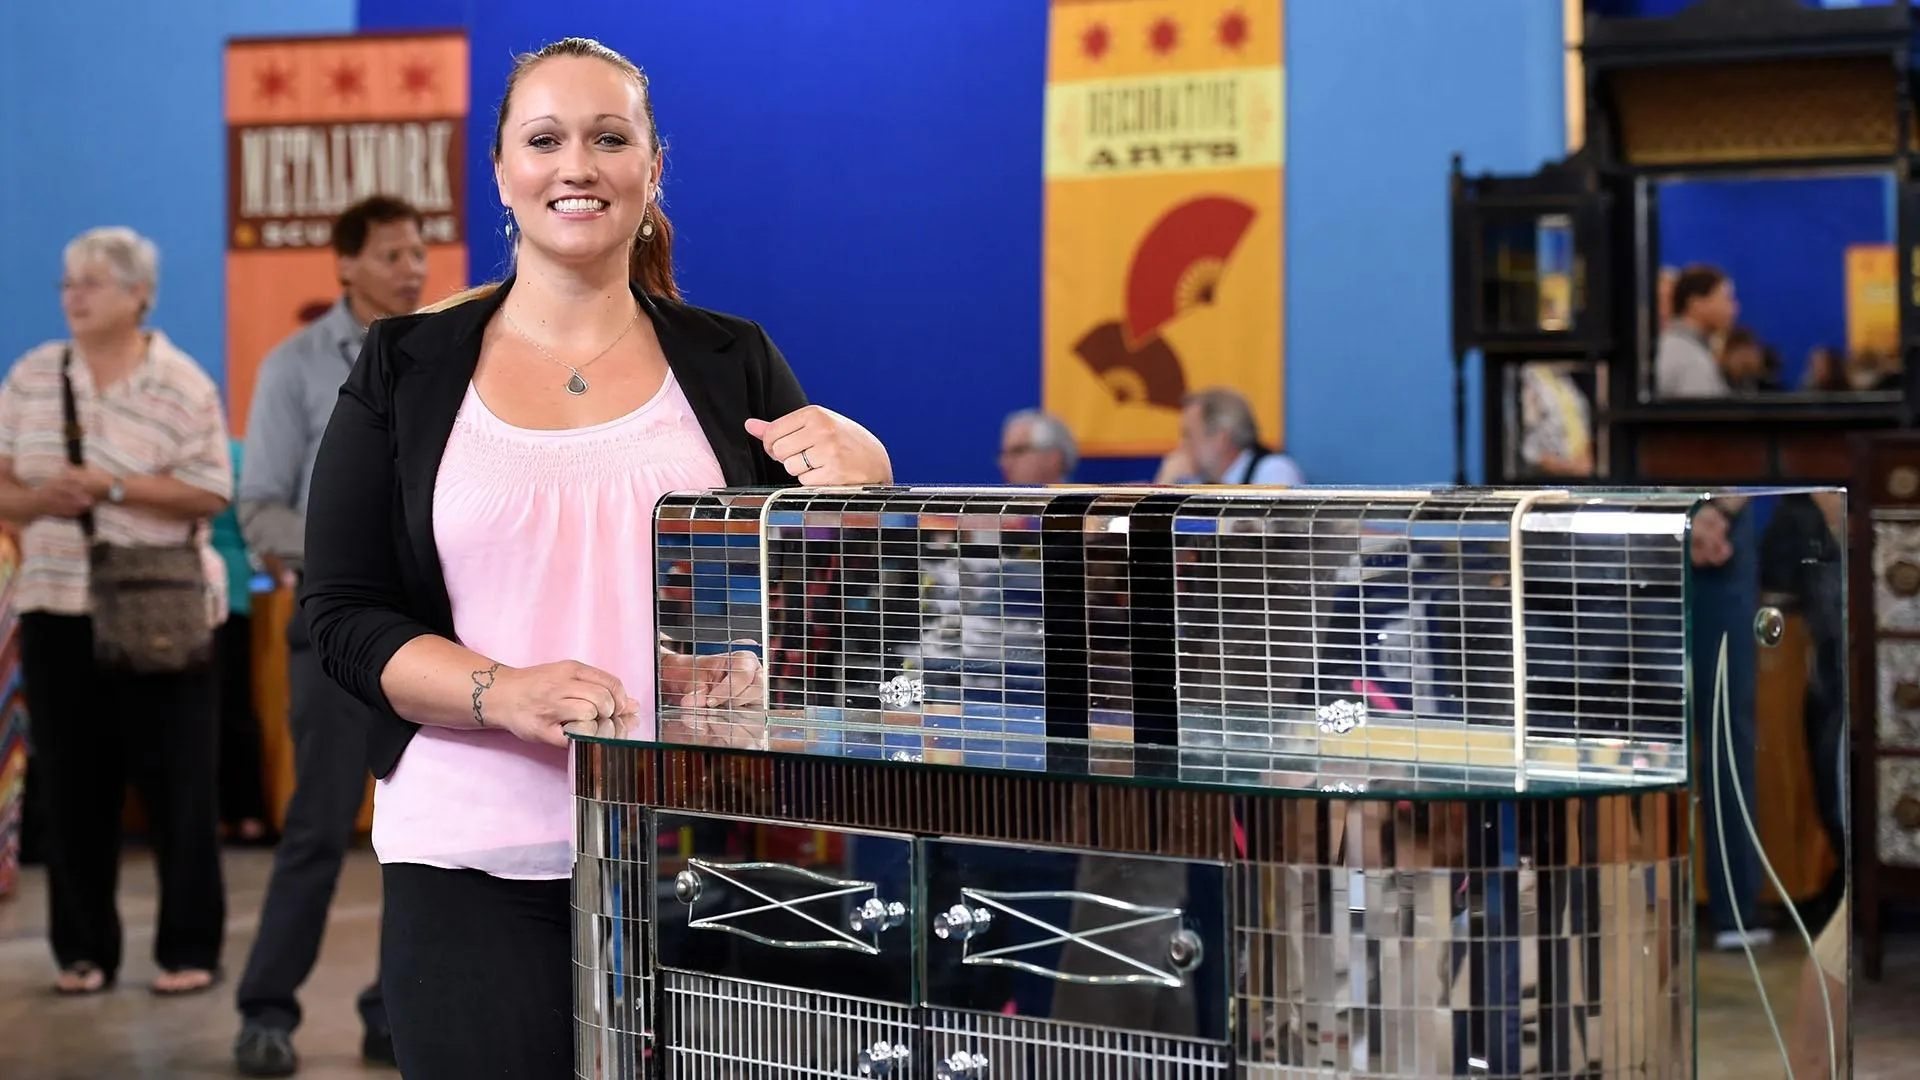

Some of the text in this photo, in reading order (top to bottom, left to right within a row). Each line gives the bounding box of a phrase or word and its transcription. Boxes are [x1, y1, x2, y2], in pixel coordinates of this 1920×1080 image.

[1089, 79, 1237, 135] DECORATIVE
[240, 122, 452, 218] METALWORK
[1088, 141, 1239, 169] ARTS
